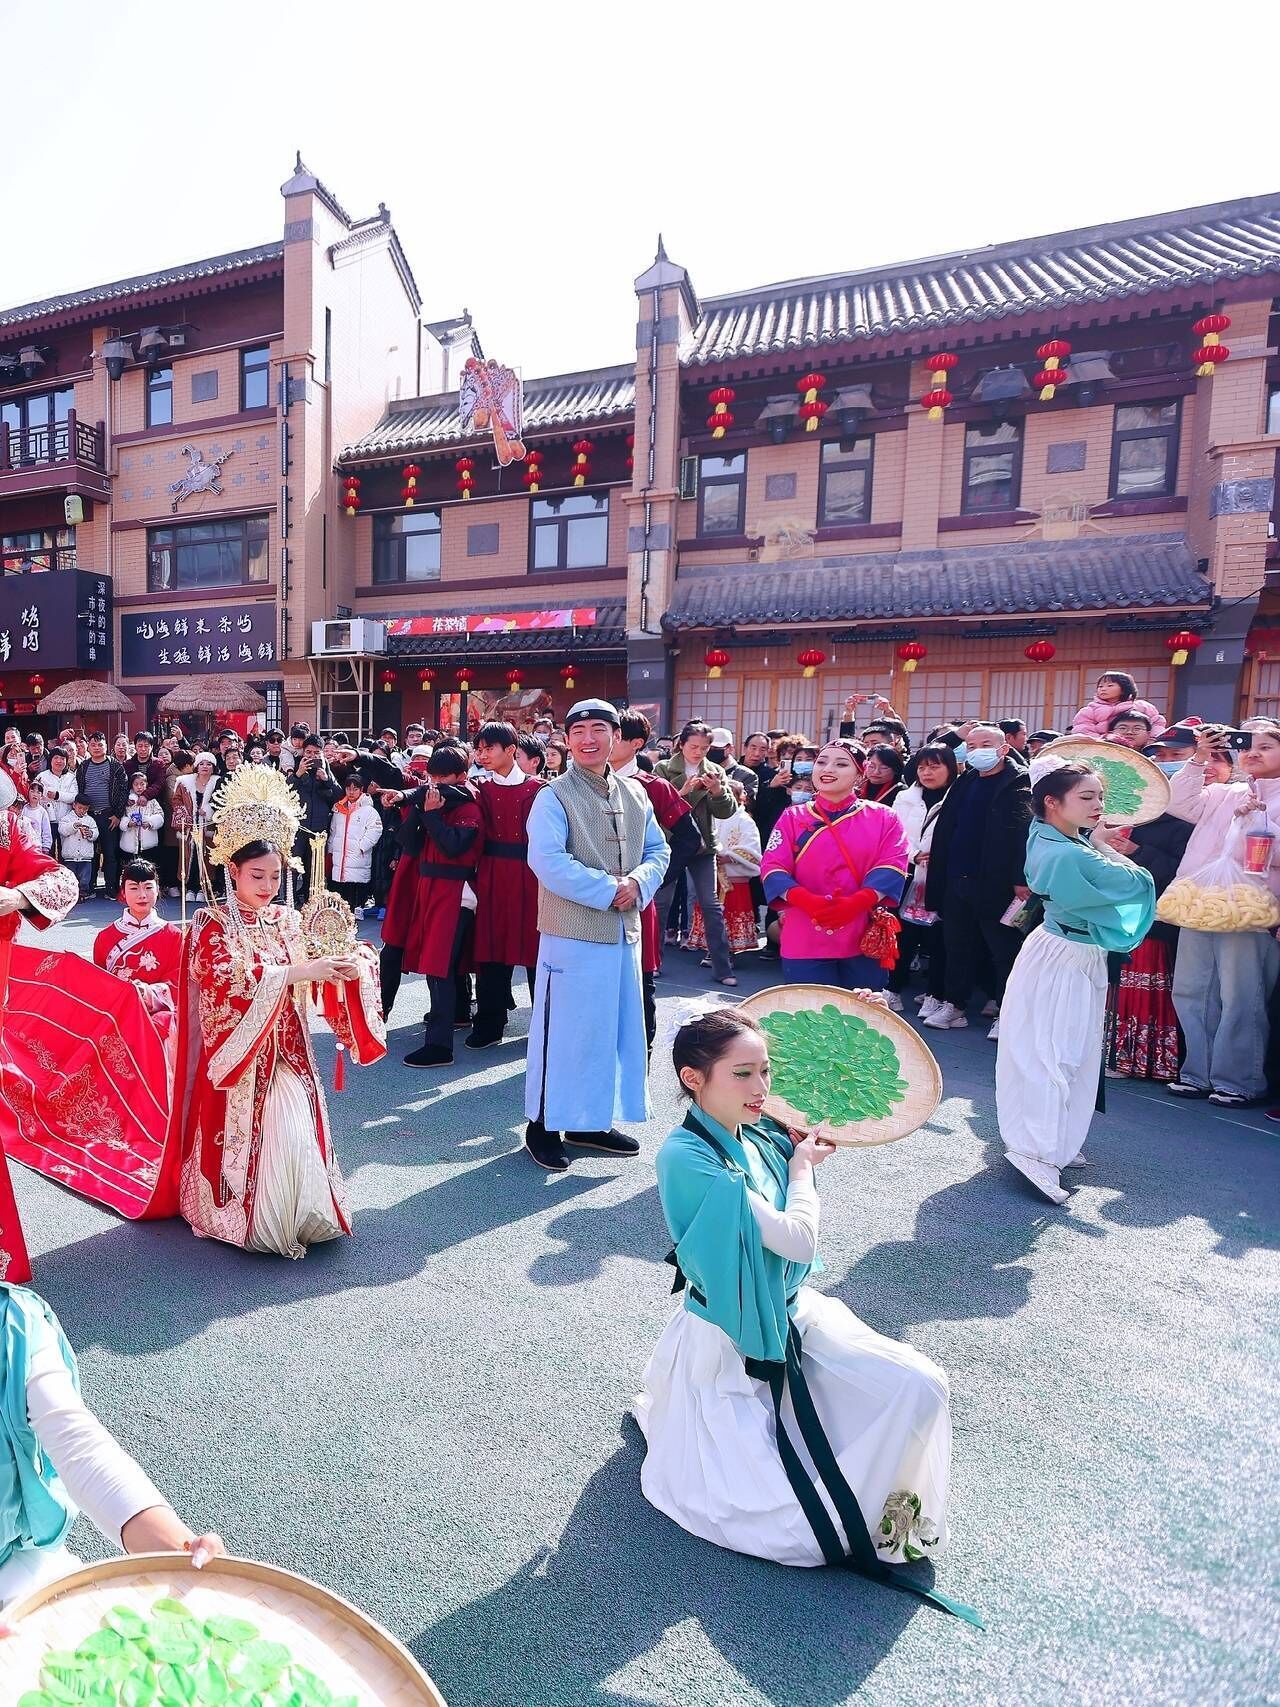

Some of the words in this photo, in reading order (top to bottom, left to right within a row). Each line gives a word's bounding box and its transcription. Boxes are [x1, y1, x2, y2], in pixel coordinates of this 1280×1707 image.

[21, 605, 39, 651] 烤肉
[88, 596, 97, 661] 市井的串
[97, 581, 106, 646] 深夜的酒
